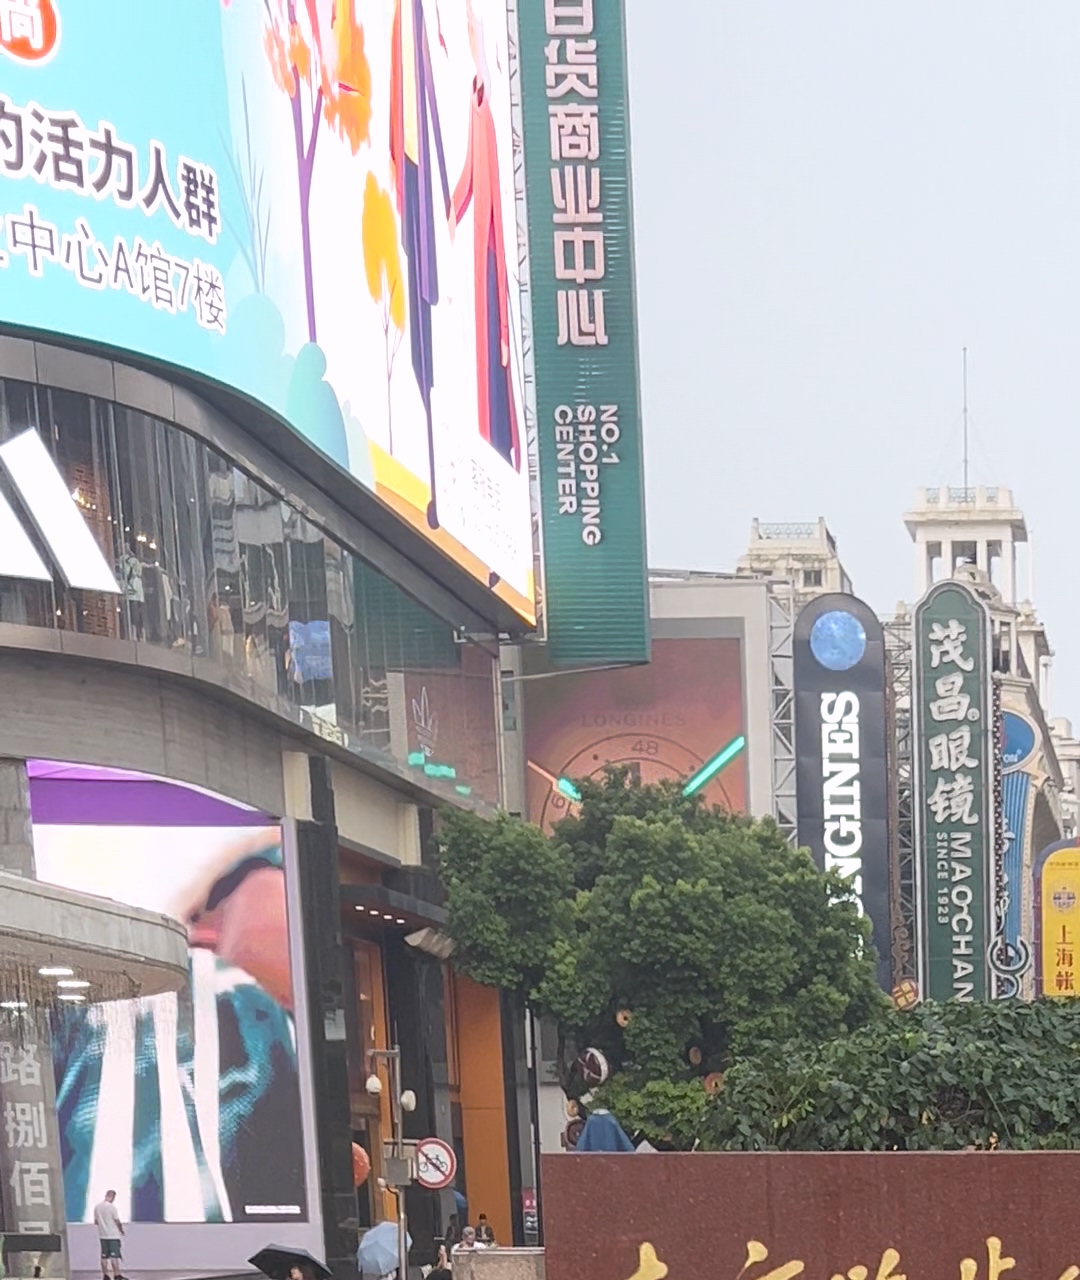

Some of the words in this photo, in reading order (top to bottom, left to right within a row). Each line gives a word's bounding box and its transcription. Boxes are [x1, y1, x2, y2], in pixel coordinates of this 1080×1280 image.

[554, 404, 577, 515] CENTER
[577, 404, 602, 546] SHOPPING
[600, 404, 620, 464] NO.1
[581, 712, 687, 728] LONGINES
[928, 618, 979, 825] 茂昌眼镜
[820, 691, 863, 960] NGINES
[936, 831, 948, 880] SINCE
[938, 887, 949, 925] 1923
